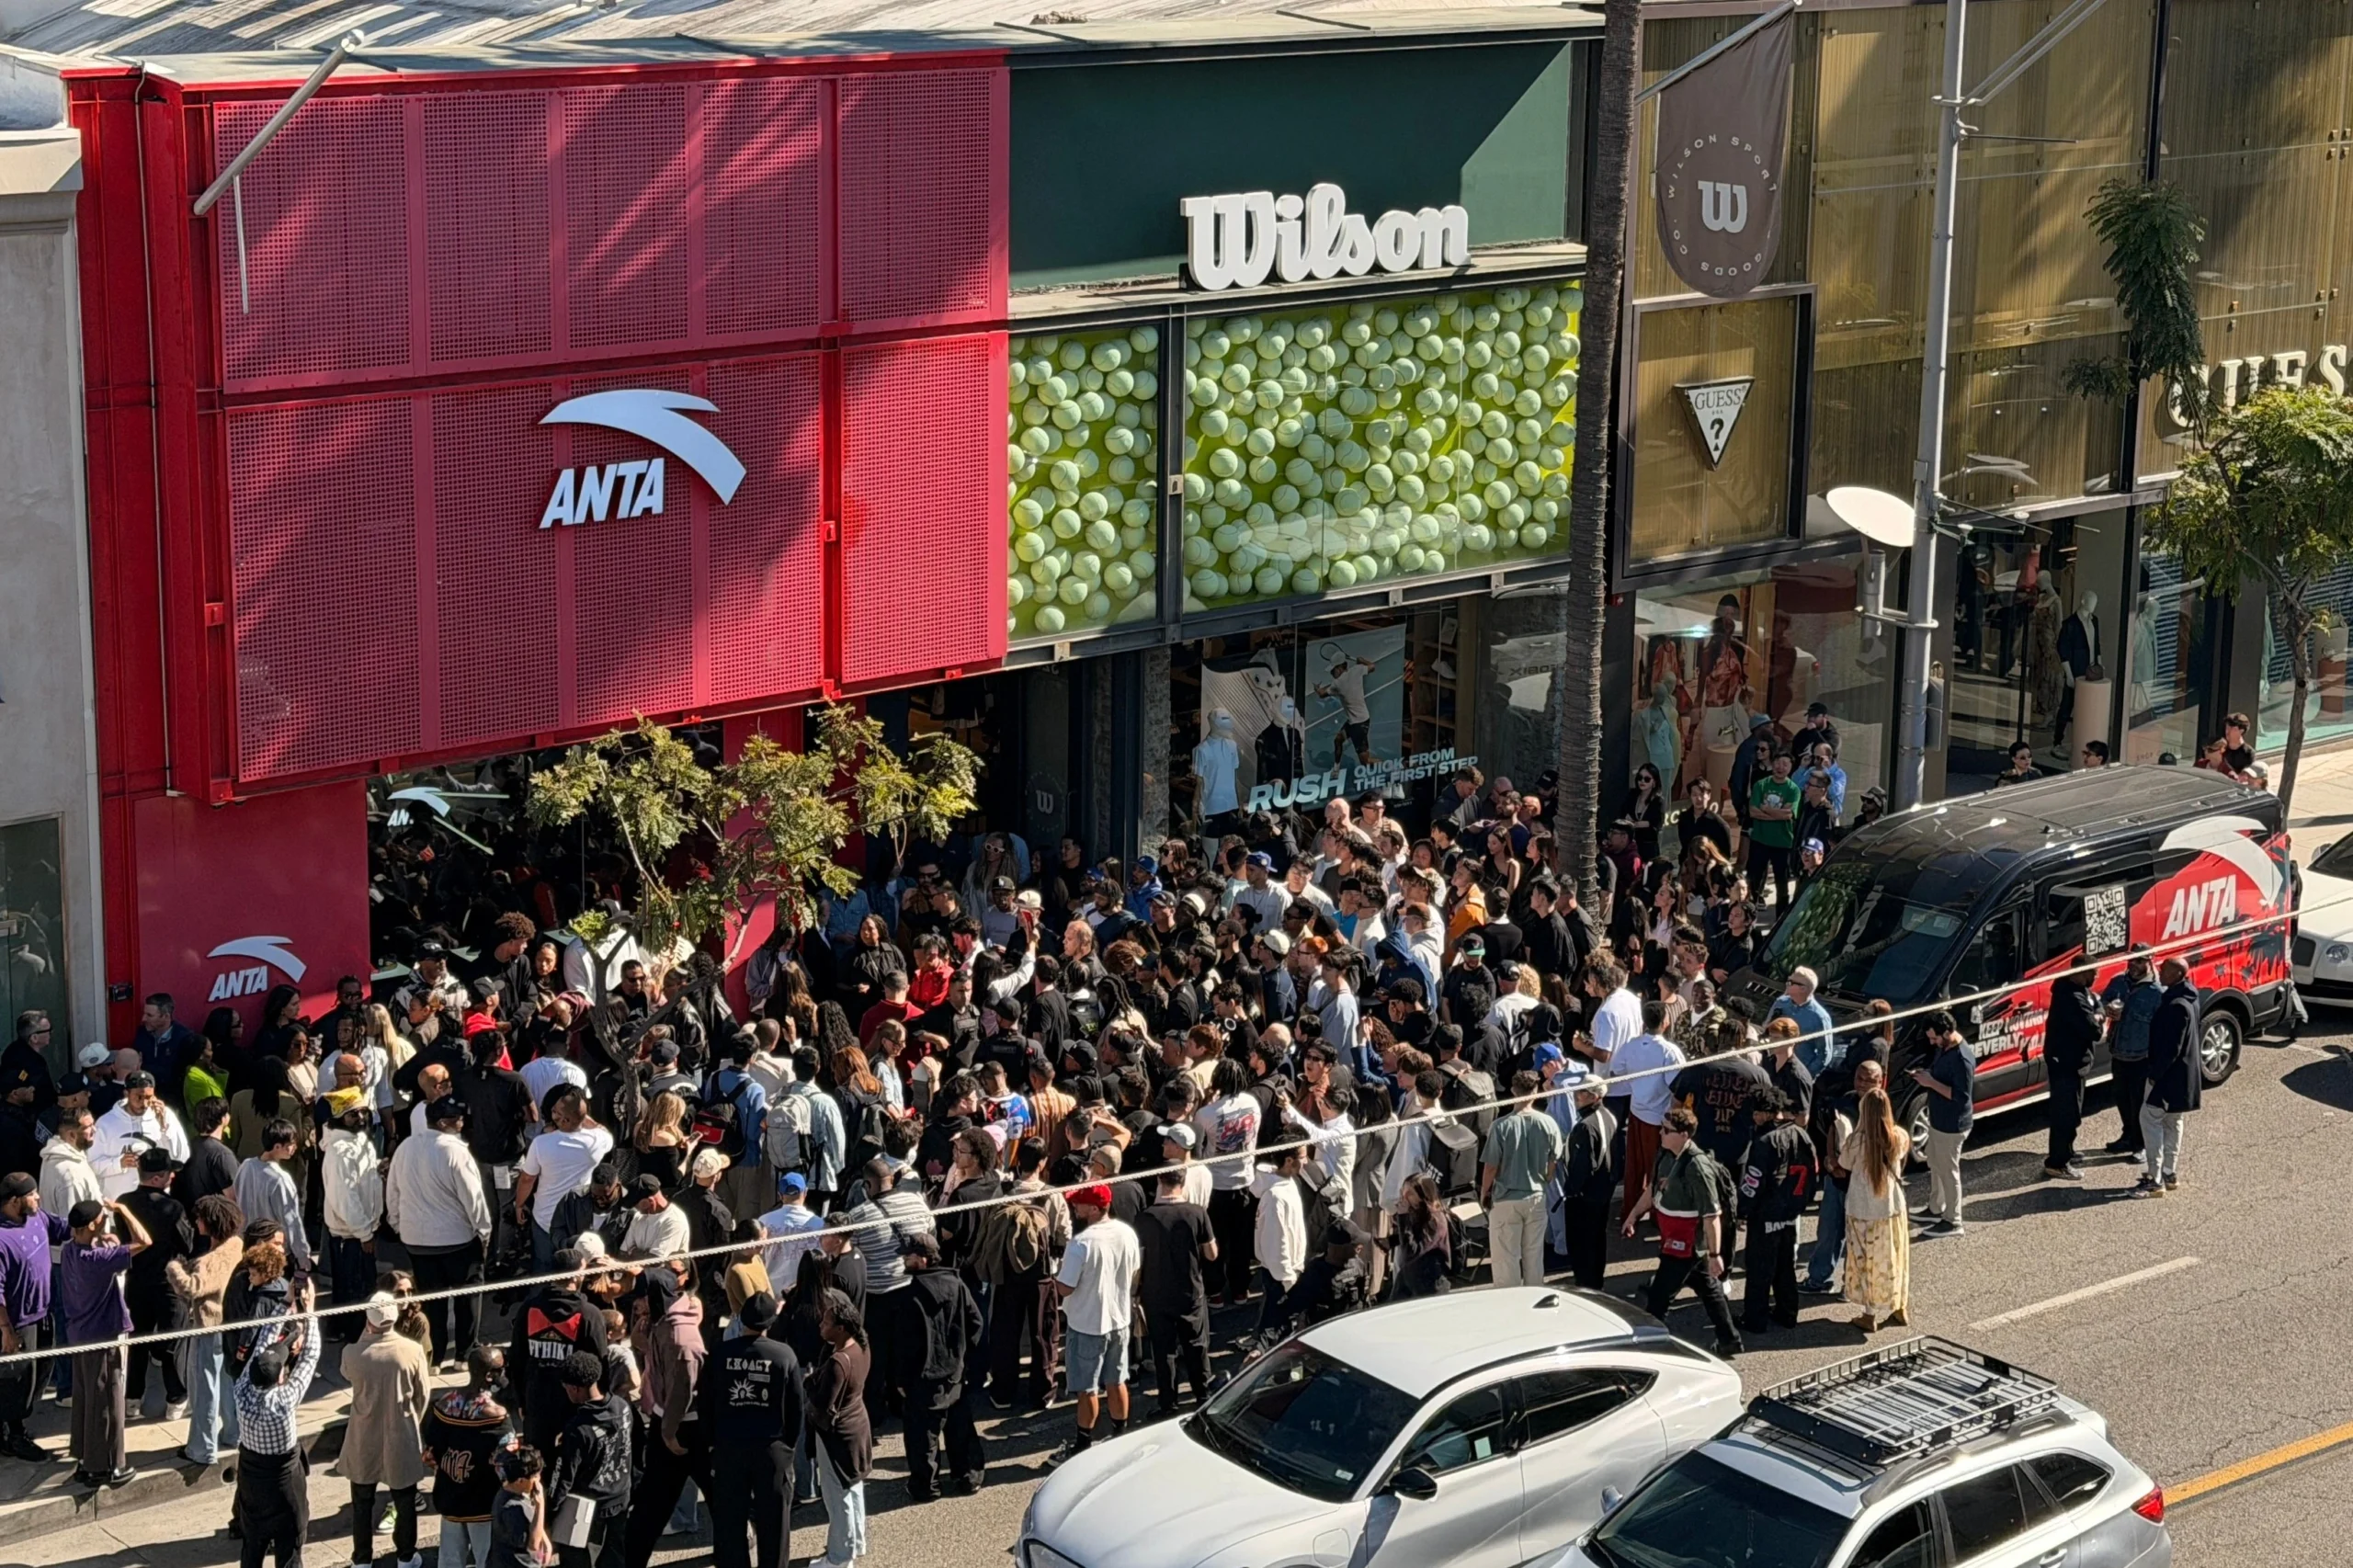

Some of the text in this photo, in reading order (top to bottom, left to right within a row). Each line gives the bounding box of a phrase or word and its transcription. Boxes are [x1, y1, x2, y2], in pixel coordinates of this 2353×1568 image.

[1667, 133, 1717, 199] WILSON
[1180, 182, 1471, 291] Wilson
[539, 458, 665, 529] ANTA
[1353, 746, 1455, 780] QUICK FROM
[1353, 756, 1479, 792] THE FIRST STEP
[1248, 767, 1347, 814] RUSH
[2162, 874, 2236, 941] ANTA
[208, 965, 267, 1003] ANTA
[1978, 1017, 2004, 1040] KEEP
[1790, 1165, 1807, 1196] 7
